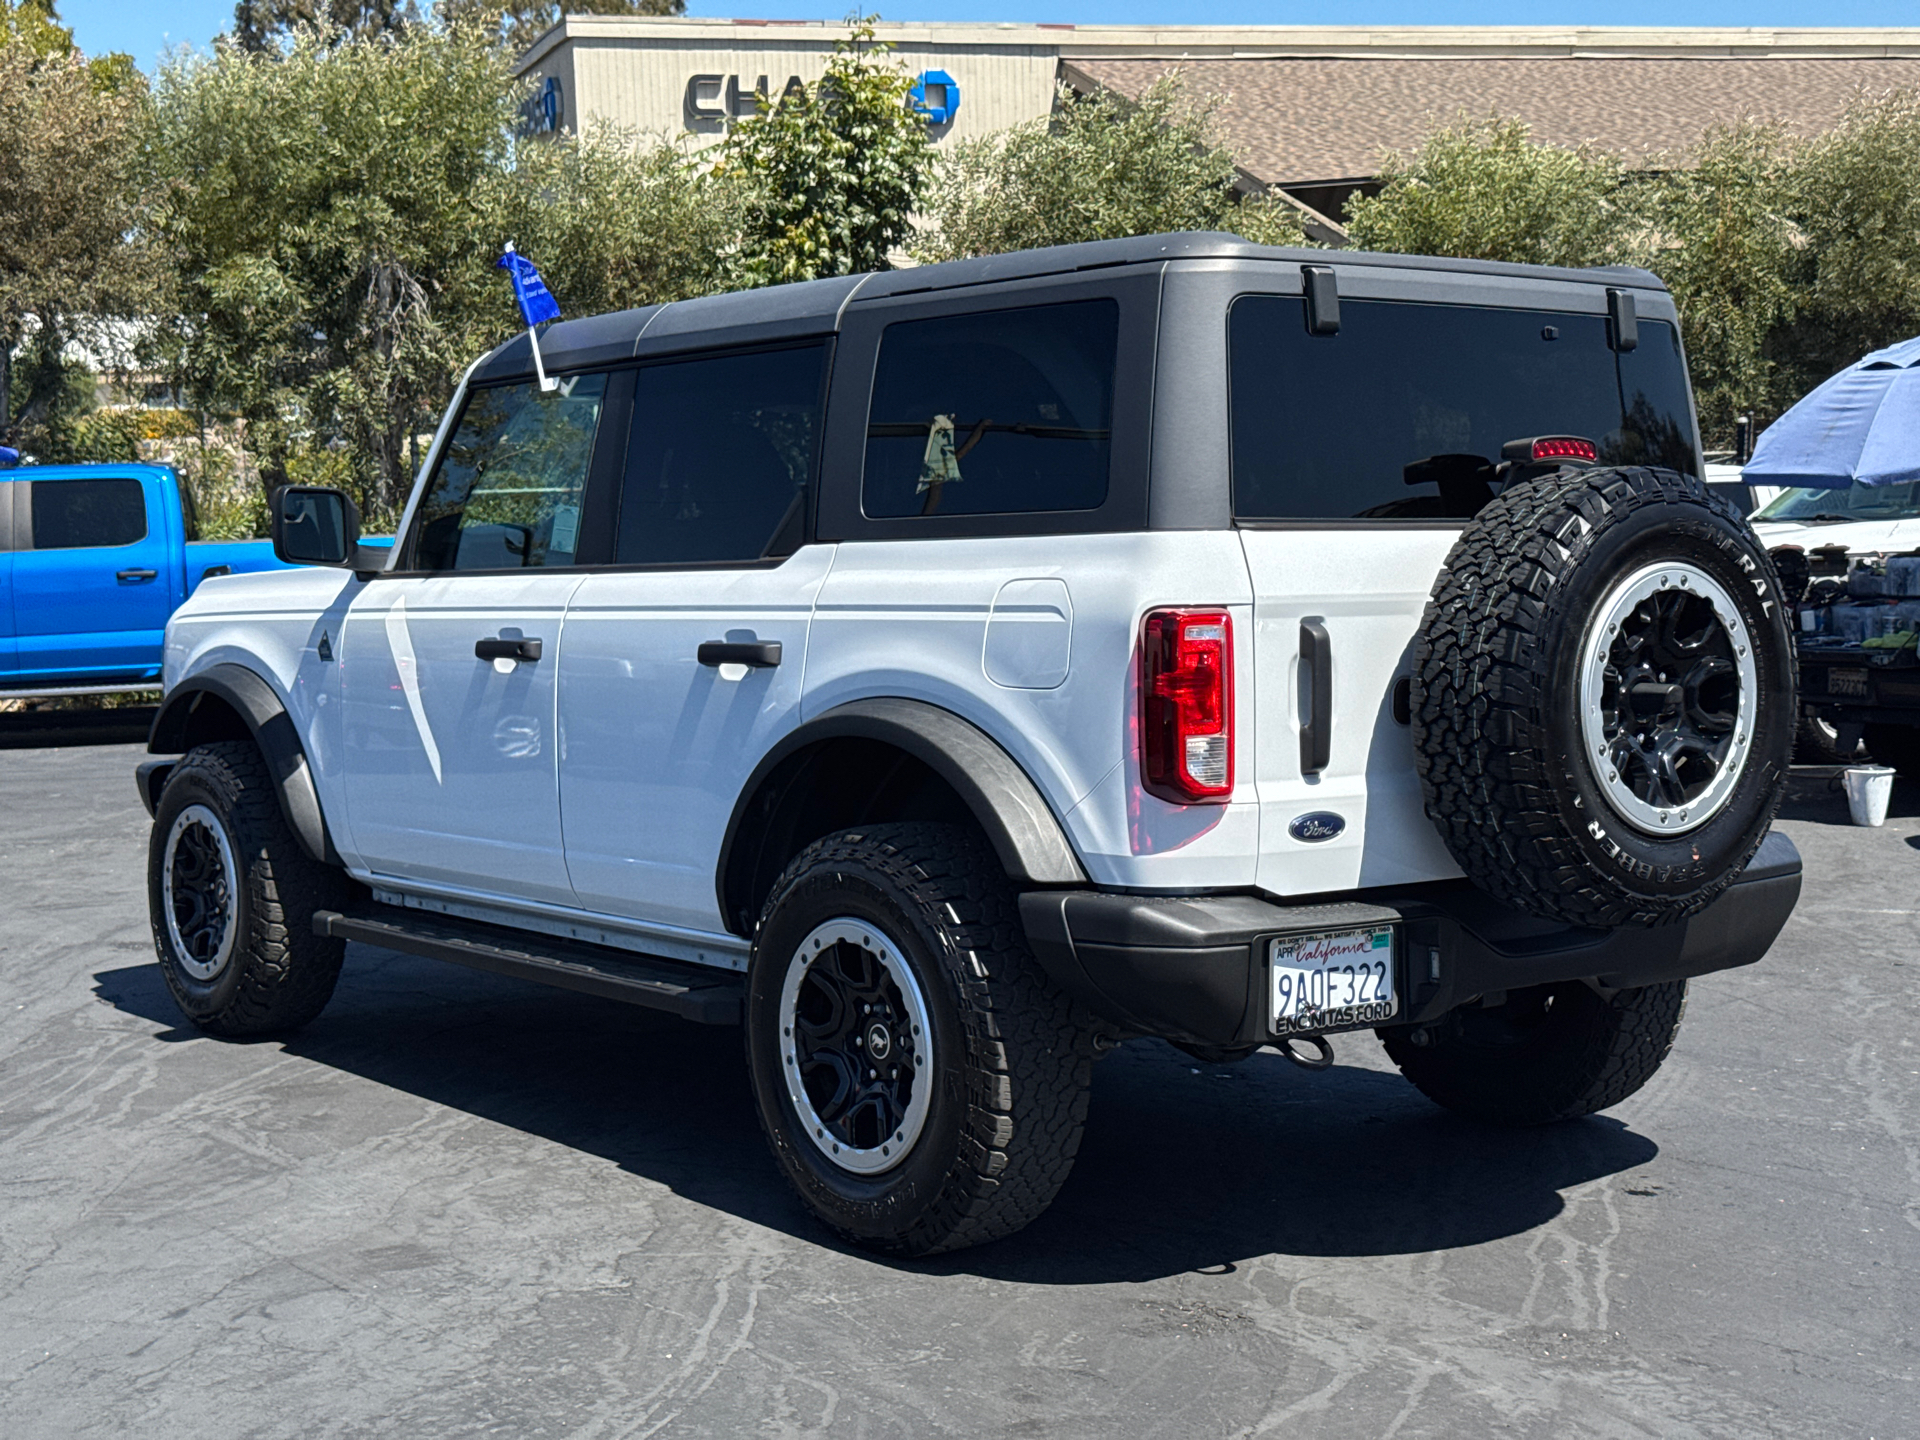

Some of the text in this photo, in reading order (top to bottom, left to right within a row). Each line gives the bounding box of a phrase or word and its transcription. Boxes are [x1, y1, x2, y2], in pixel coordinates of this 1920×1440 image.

[1303, 820, 1334, 837] Ford
[1277, 946, 1294, 960] APR
[1296, 940, 1372, 966] California
[1276, 1001, 1393, 1034] ENCINITAS FORD
